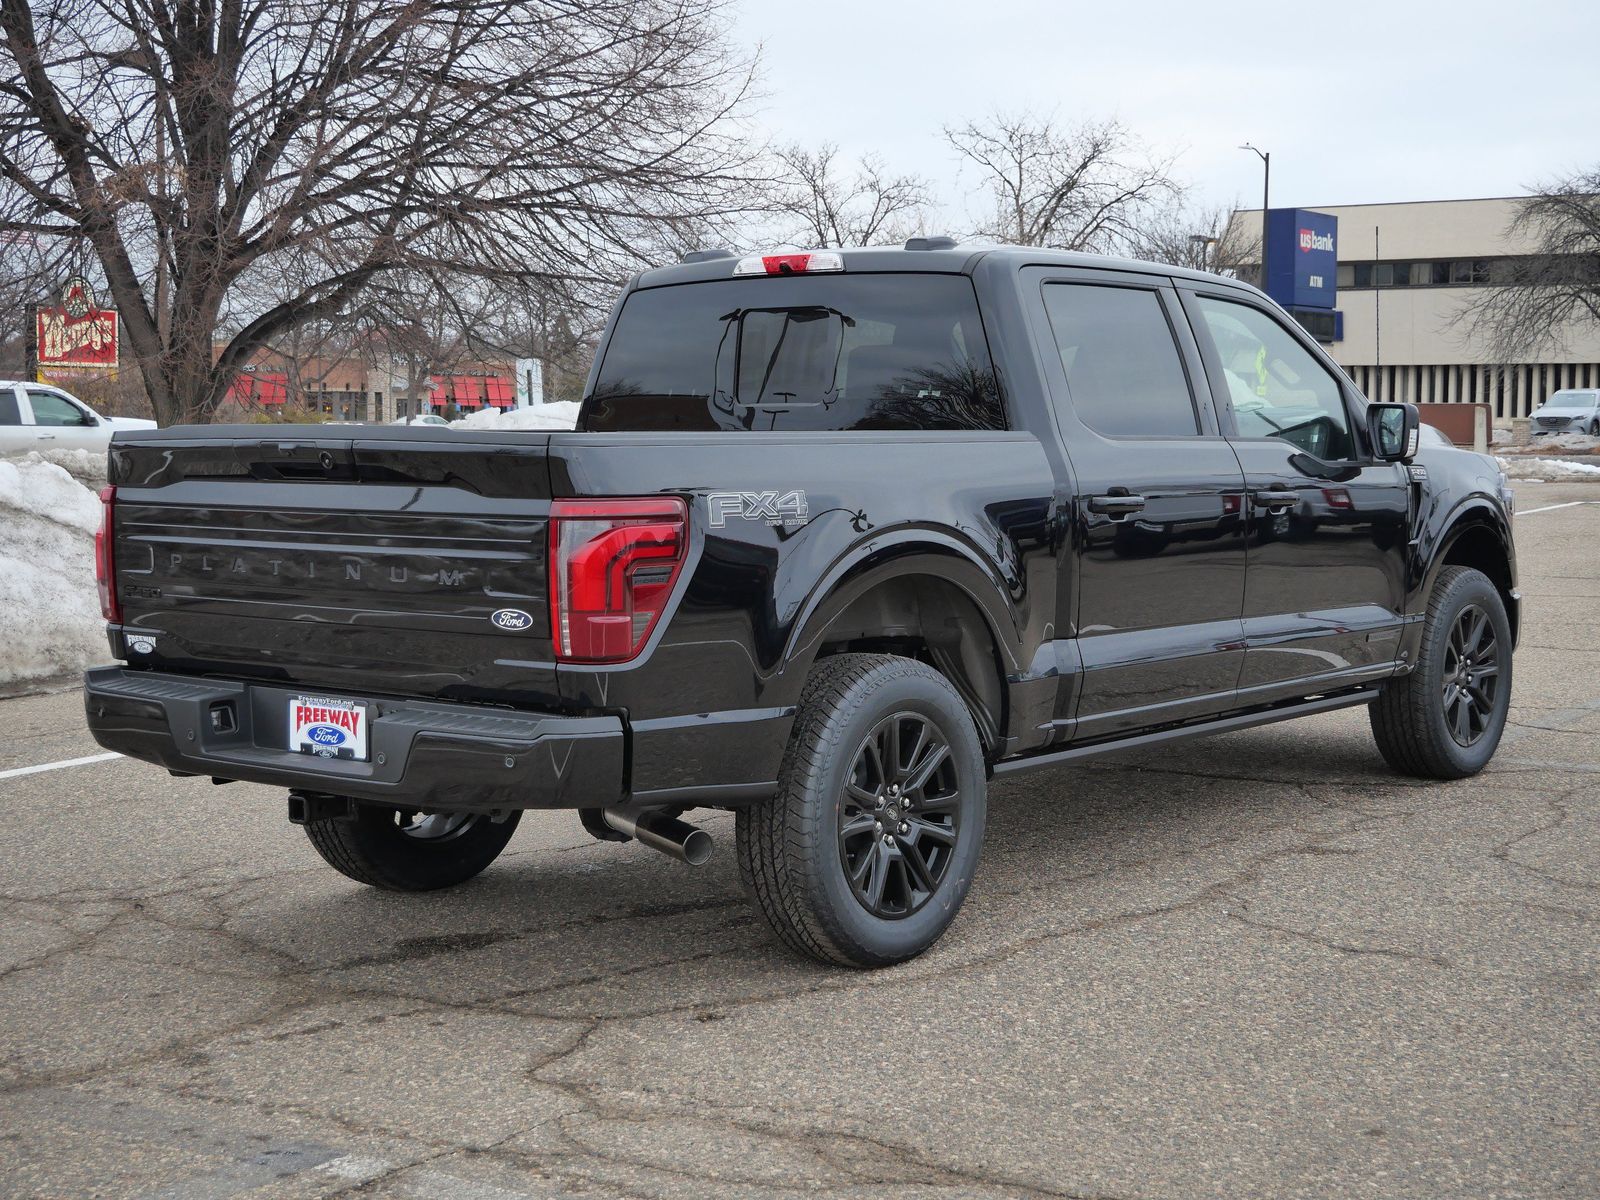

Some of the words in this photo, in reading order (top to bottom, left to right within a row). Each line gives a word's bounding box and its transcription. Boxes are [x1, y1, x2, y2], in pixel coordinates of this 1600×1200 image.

[1309, 275, 1323, 288] ATM
[707, 489, 809, 529] FX4
[170, 553, 461, 586] PLATINUM
[498, 610, 526, 628] Ford
[126, 634, 157, 648] FREEWAY
[296, 706, 360, 740] FREEWAY
[314, 727, 339, 744] Ford
